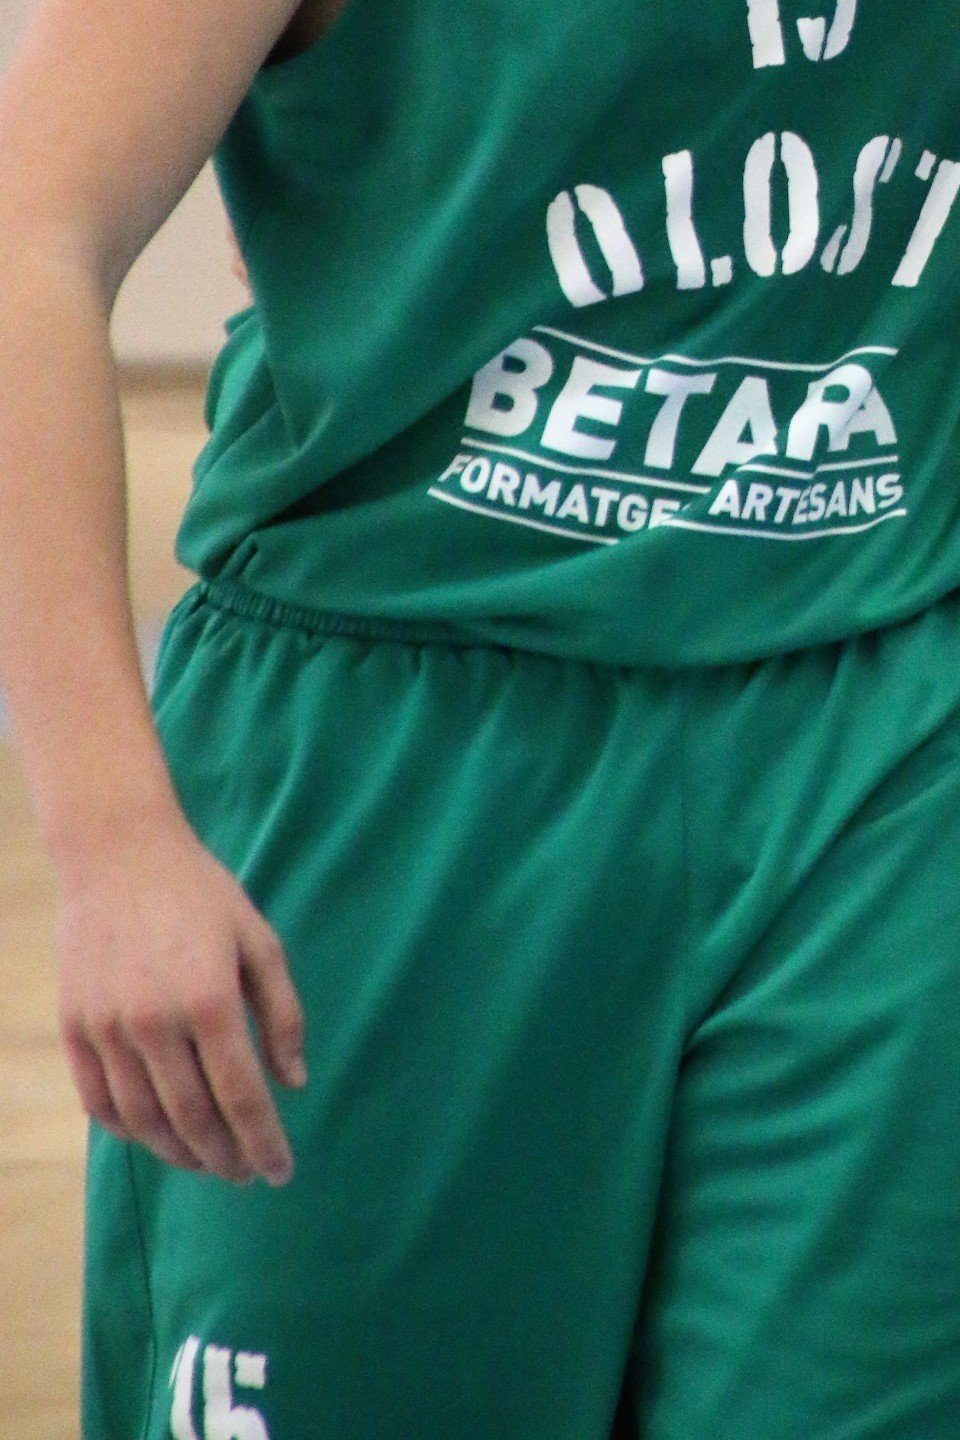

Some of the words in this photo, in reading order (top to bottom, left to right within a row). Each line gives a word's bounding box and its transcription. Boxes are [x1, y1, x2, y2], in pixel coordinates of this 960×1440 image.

[463, 338, 898, 477] BETARA
[438, 453, 691, 532] FORMATGE
[708, 472, 904, 526] ARTESANS
[168, 1334, 269, 1440] 15
